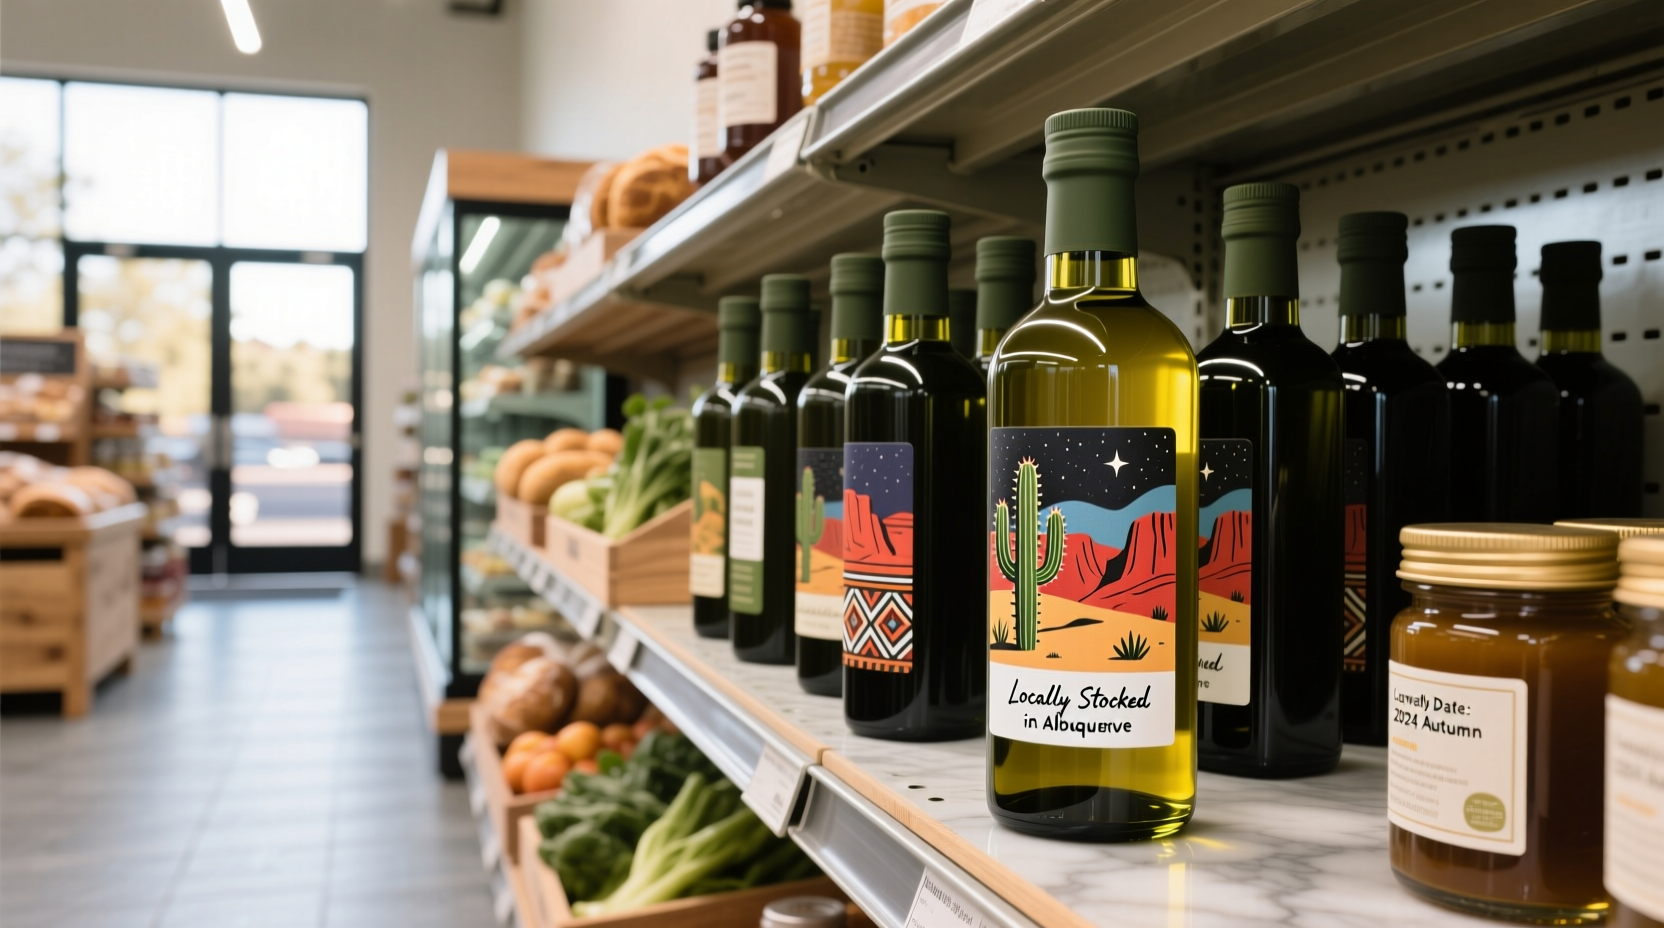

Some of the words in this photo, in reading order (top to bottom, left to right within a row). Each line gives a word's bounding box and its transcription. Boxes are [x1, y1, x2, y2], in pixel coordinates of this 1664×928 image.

[1008, 678, 1071, 718] Locally
[1077, 684, 1151, 709] Stocked
[1433, 696, 1471, 716] Date:
[1024, 713, 1038, 729] in
[1393, 707, 1418, 730] 2024
[1421, 715, 1482, 739] Autumn
